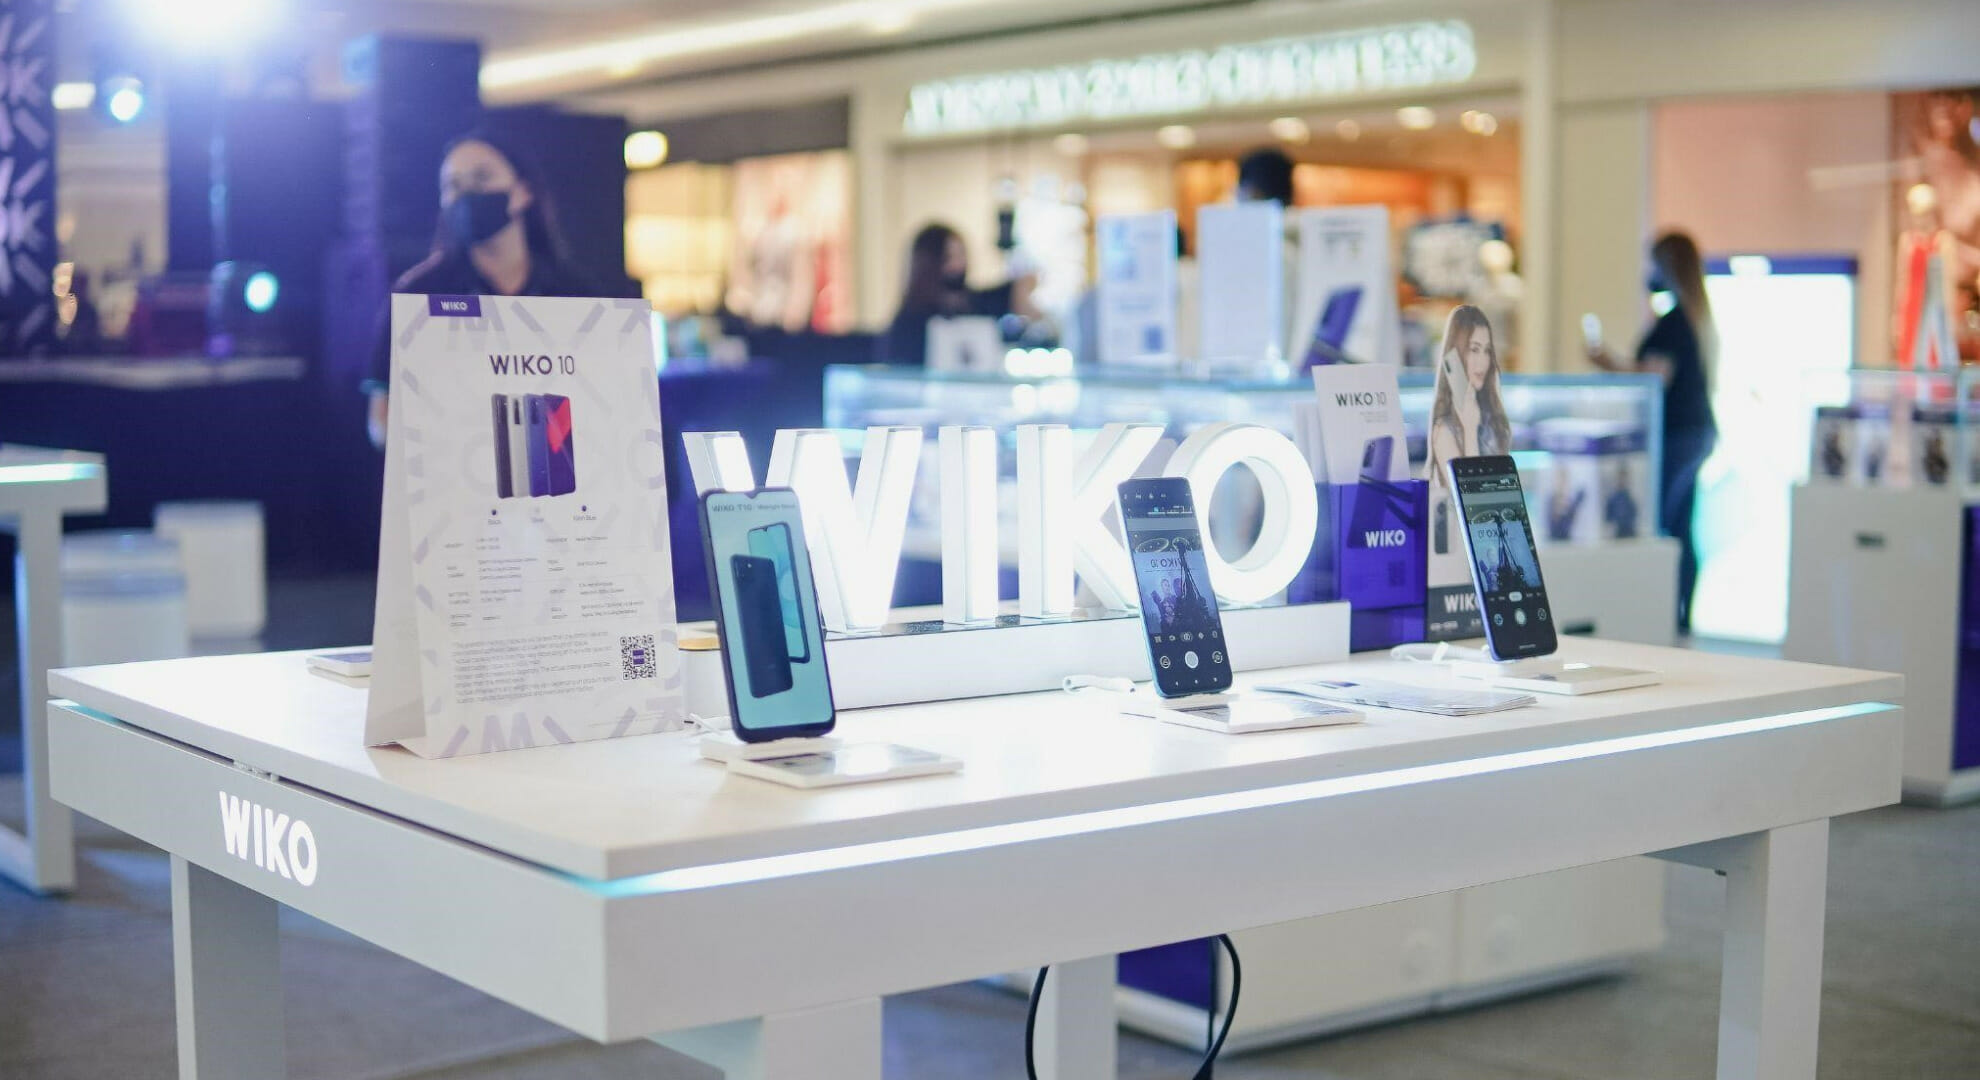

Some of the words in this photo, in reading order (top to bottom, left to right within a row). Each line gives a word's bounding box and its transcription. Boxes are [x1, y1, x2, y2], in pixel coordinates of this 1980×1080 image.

[440, 300, 469, 312] WIKO
[489, 354, 553, 376] WIKO
[558, 355, 576, 376] 10
[1335, 391, 1374, 407] WIKO
[1375, 391, 1388, 405] 10
[681, 421, 1319, 634] WIKO
[1365, 529, 1406, 549] WIKO
[219, 791, 318, 887] WIKO
